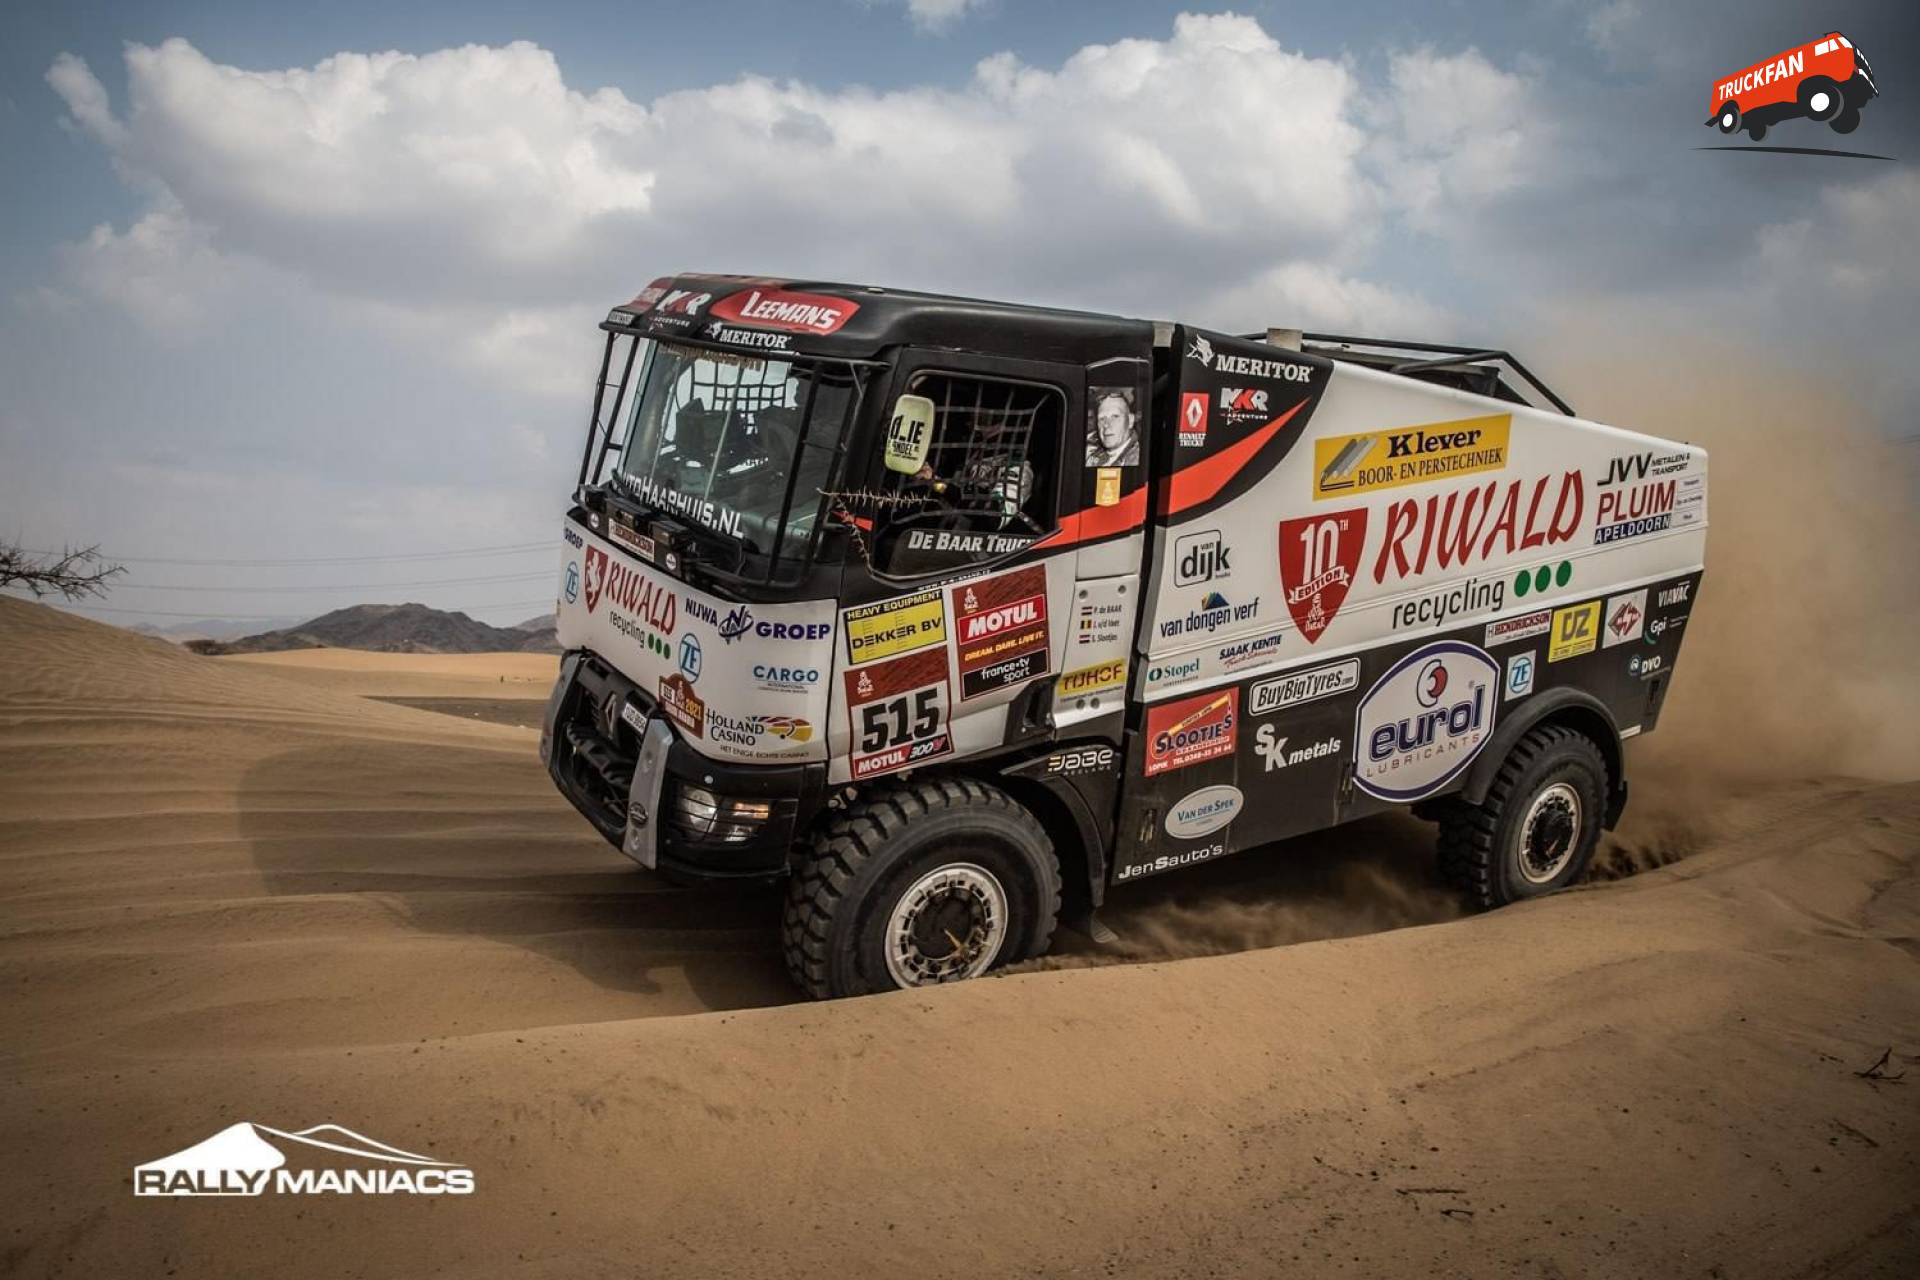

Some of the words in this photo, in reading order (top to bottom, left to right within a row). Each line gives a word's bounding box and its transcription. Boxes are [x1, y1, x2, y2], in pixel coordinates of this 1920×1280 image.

[740, 290, 842, 330] LEEMANS
[719, 328, 788, 349] MERITOR
[1215, 353, 1312, 383] MERITOR
[1220, 387, 1269, 412] MKR
[1387, 429, 1482, 459] Klever
[1358, 464, 1397, 487] BOOR-
[1400, 462, 1416, 480] EN
[1419, 447, 1503, 477] PERSTECHNIEK
[1597, 451, 1653, 486] JVV
[1596, 479, 1677, 526] PLUIM
[908, 531, 934, 549] DE
[935, 532, 984, 552] BAAR
[1373, 469, 1584, 585] RIWALD
[1595, 514, 1671, 545] APELDOORN
[1201, 541, 1214, 551] van
[606, 561, 677, 635] RIWALD
[1297, 569, 1341, 599] EDITION
[847, 605, 881, 620] HEAVY
[883, 591, 941, 611] EQUIPMENT
[1160, 618, 1182, 638] van
[1186, 608, 1231, 632] dongen
[1234, 597, 1260, 621] verf
[1392, 577, 1506, 629] recycling
[609, 611, 646, 649] recycling
[755, 621, 831, 640] GROEP
[852, 624, 917, 649] DEKKER
[921, 617, 942, 632] BV
[968, 601, 1037, 639] MOTUL
[753, 665, 819, 682] CARGO
[1003, 666, 1030, 684] sport
[1511, 662, 1531, 688] ZF
[706, 707, 765, 735] HOLLAND
[862, 686, 940, 754] 515
[1369, 684, 1486, 763] eurol
[710, 725, 756, 746] CASINO
[858, 750, 906, 774] MOTUL
[1289, 737, 1342, 766] metals
[1366, 733, 1480, 778] LUBRICANTS
[1177, 810, 1196, 822] VAN
